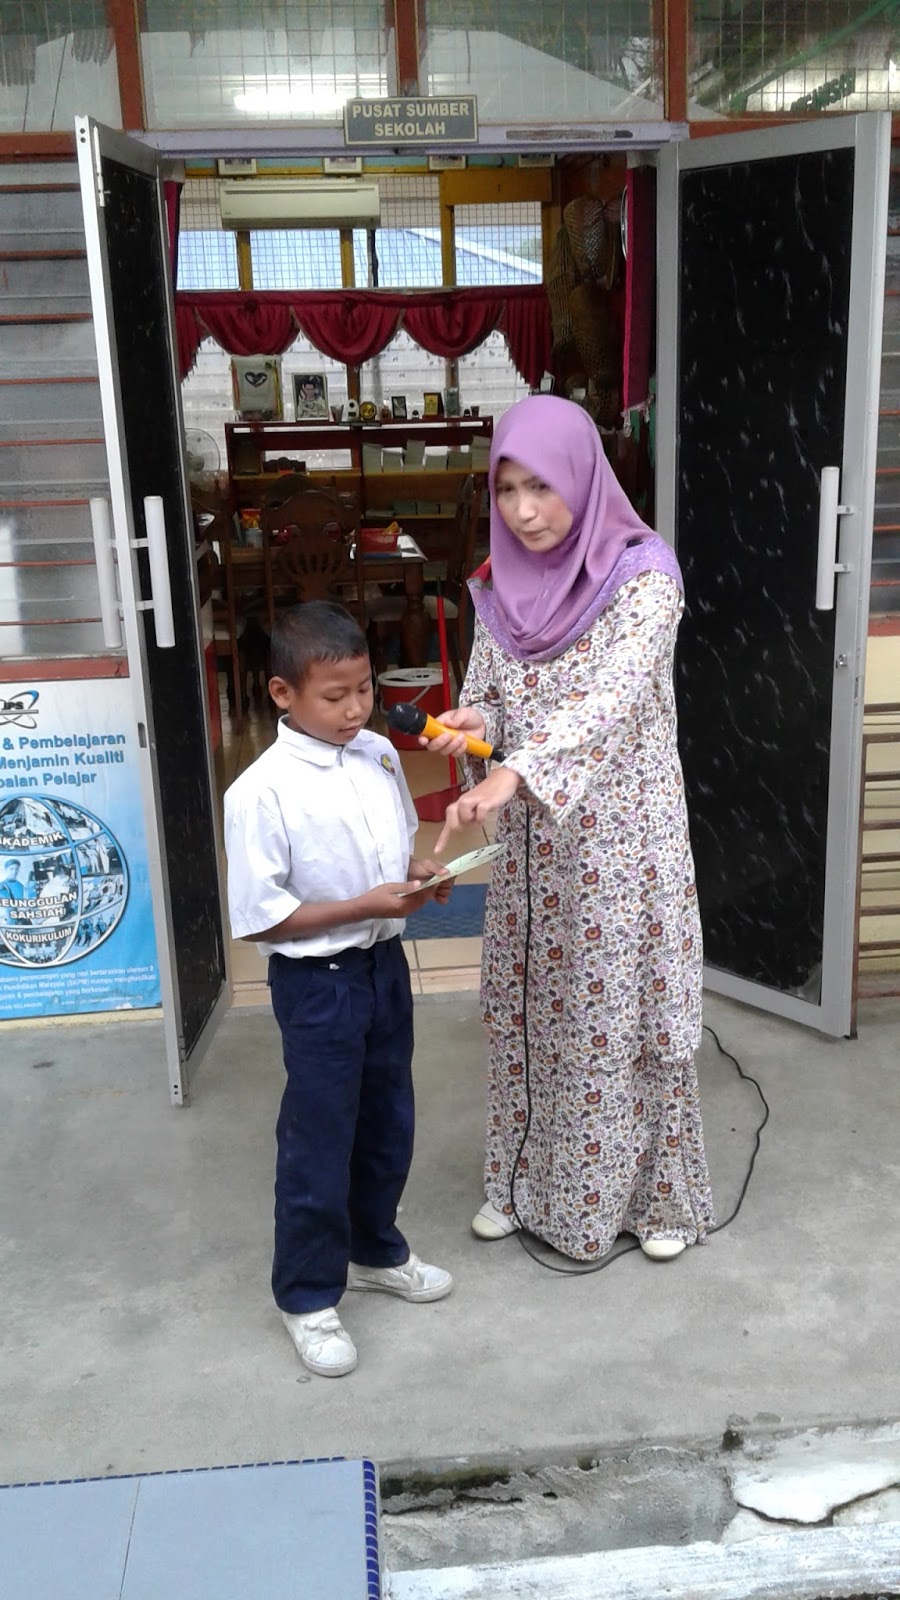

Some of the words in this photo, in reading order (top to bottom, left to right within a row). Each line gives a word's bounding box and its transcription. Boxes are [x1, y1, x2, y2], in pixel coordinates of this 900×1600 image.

[352, 104, 401, 118] PUSAT
[406, 103, 470, 117] SUMBER
[374, 122, 446, 137] SEKOLAH
[2, 737, 14, 750] &
[19, 733, 126, 750] Pembelajaran
[74, 750, 125, 765] Kualiti
[42, 771, 97, 787] Pelajar
[0, 892, 77, 907] EUNGGULAN
[10, 907, 63, 919] SAHSIAH
[6, 927, 72, 943] KOKURIKULUM
